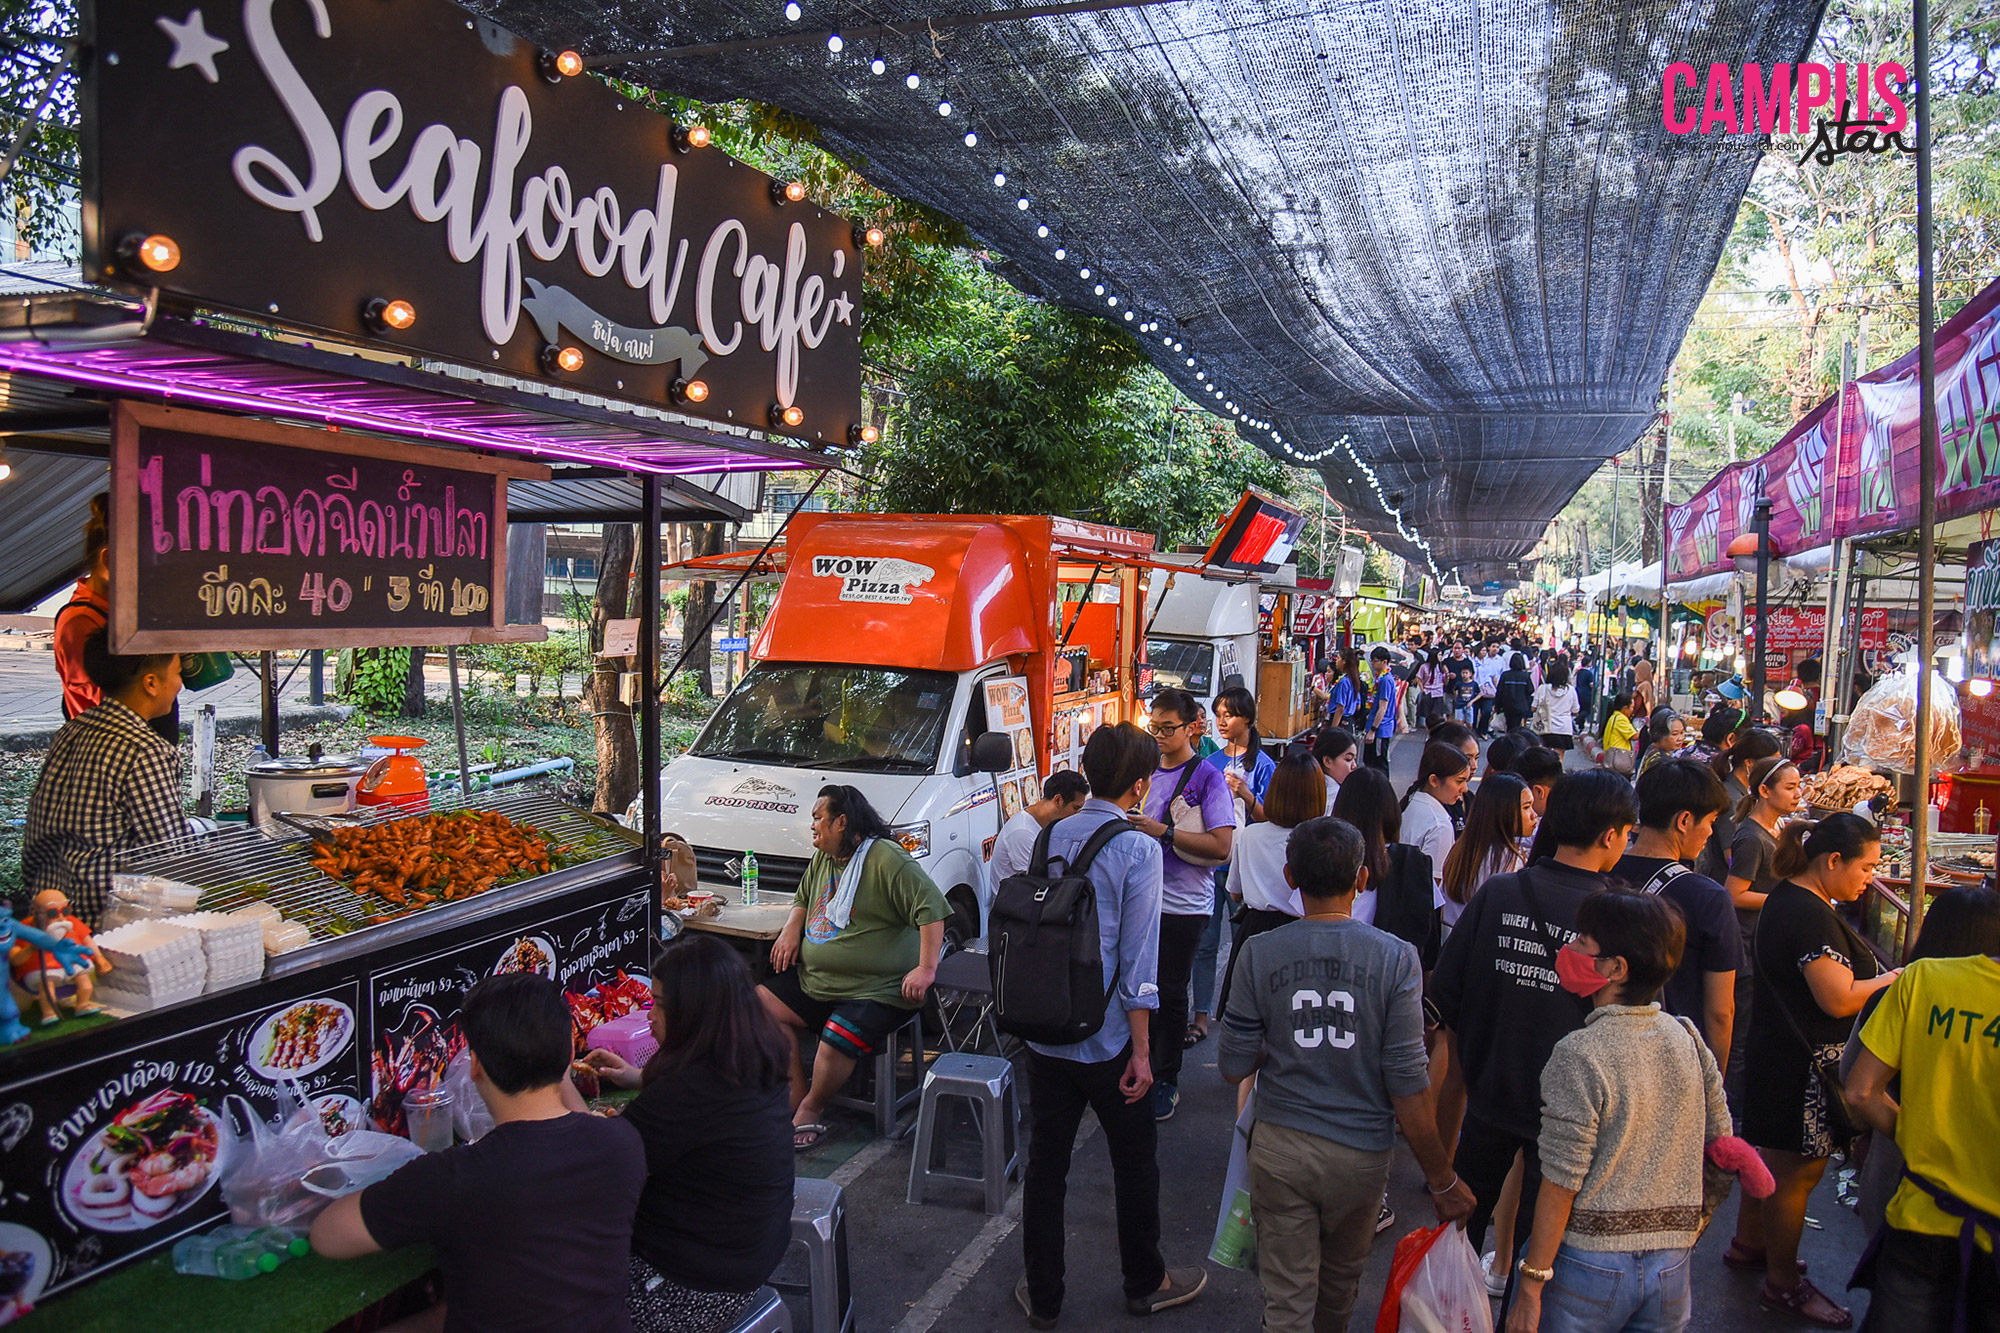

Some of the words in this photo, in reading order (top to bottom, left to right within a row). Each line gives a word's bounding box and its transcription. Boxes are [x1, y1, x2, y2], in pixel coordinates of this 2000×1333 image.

[232, 0, 689, 347] Seafood
[815, 558, 878, 576] WOW
[299, 572, 352, 616] 40
[387, 575, 411, 612] 3
[450, 577, 489, 616] 100
[846, 578, 900, 594] Pizza
[988, 687, 1009, 702] WOW
[1003, 705, 1020, 718] Pizza
[705, 796, 746, 807] FOOD
[746, 800, 799, 814] TRUCK
[1502, 912, 1530, 929] WHEN
